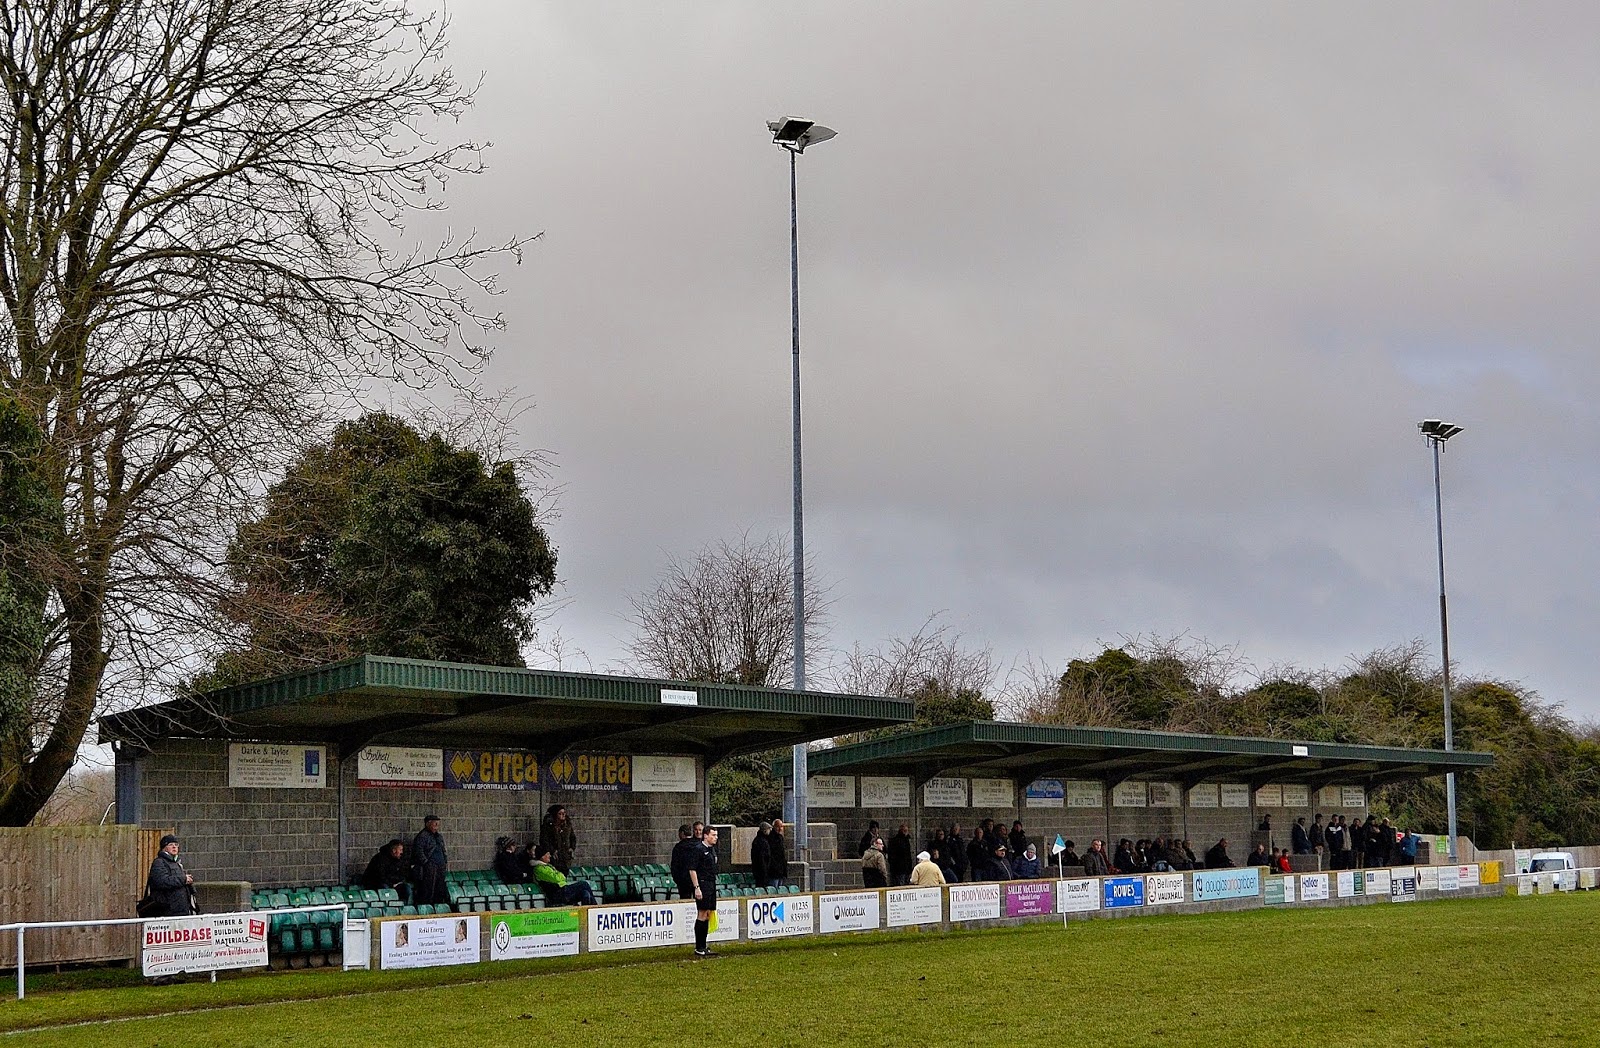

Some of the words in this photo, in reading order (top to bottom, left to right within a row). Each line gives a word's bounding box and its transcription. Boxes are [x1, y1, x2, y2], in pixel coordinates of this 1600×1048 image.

[242, 746, 260, 754] Darke
[271, 747, 289, 756] Taylor
[381, 763, 403, 777] Spice
[1157, 878, 1183, 890] Bellinger
[903, 892, 917, 901] HOTEL
[1114, 884, 1134, 897] ROWES
[1158, 891, 1183, 900] VAUXHALL
[792, 902, 808, 911] 01235
[752, 901, 778, 925] OPC
[597, 912, 652, 930] FARNTECH
[656, 910, 673, 926] LTD
[146, 927, 211, 944] BUILDBASE
[214, 927, 244, 935] BUILDING
[215, 936, 249, 945] MATERIALS
[597, 935, 621, 945] GRAB
[624, 932, 652, 942] LORRY
[655, 930, 673, 940] HIRE
